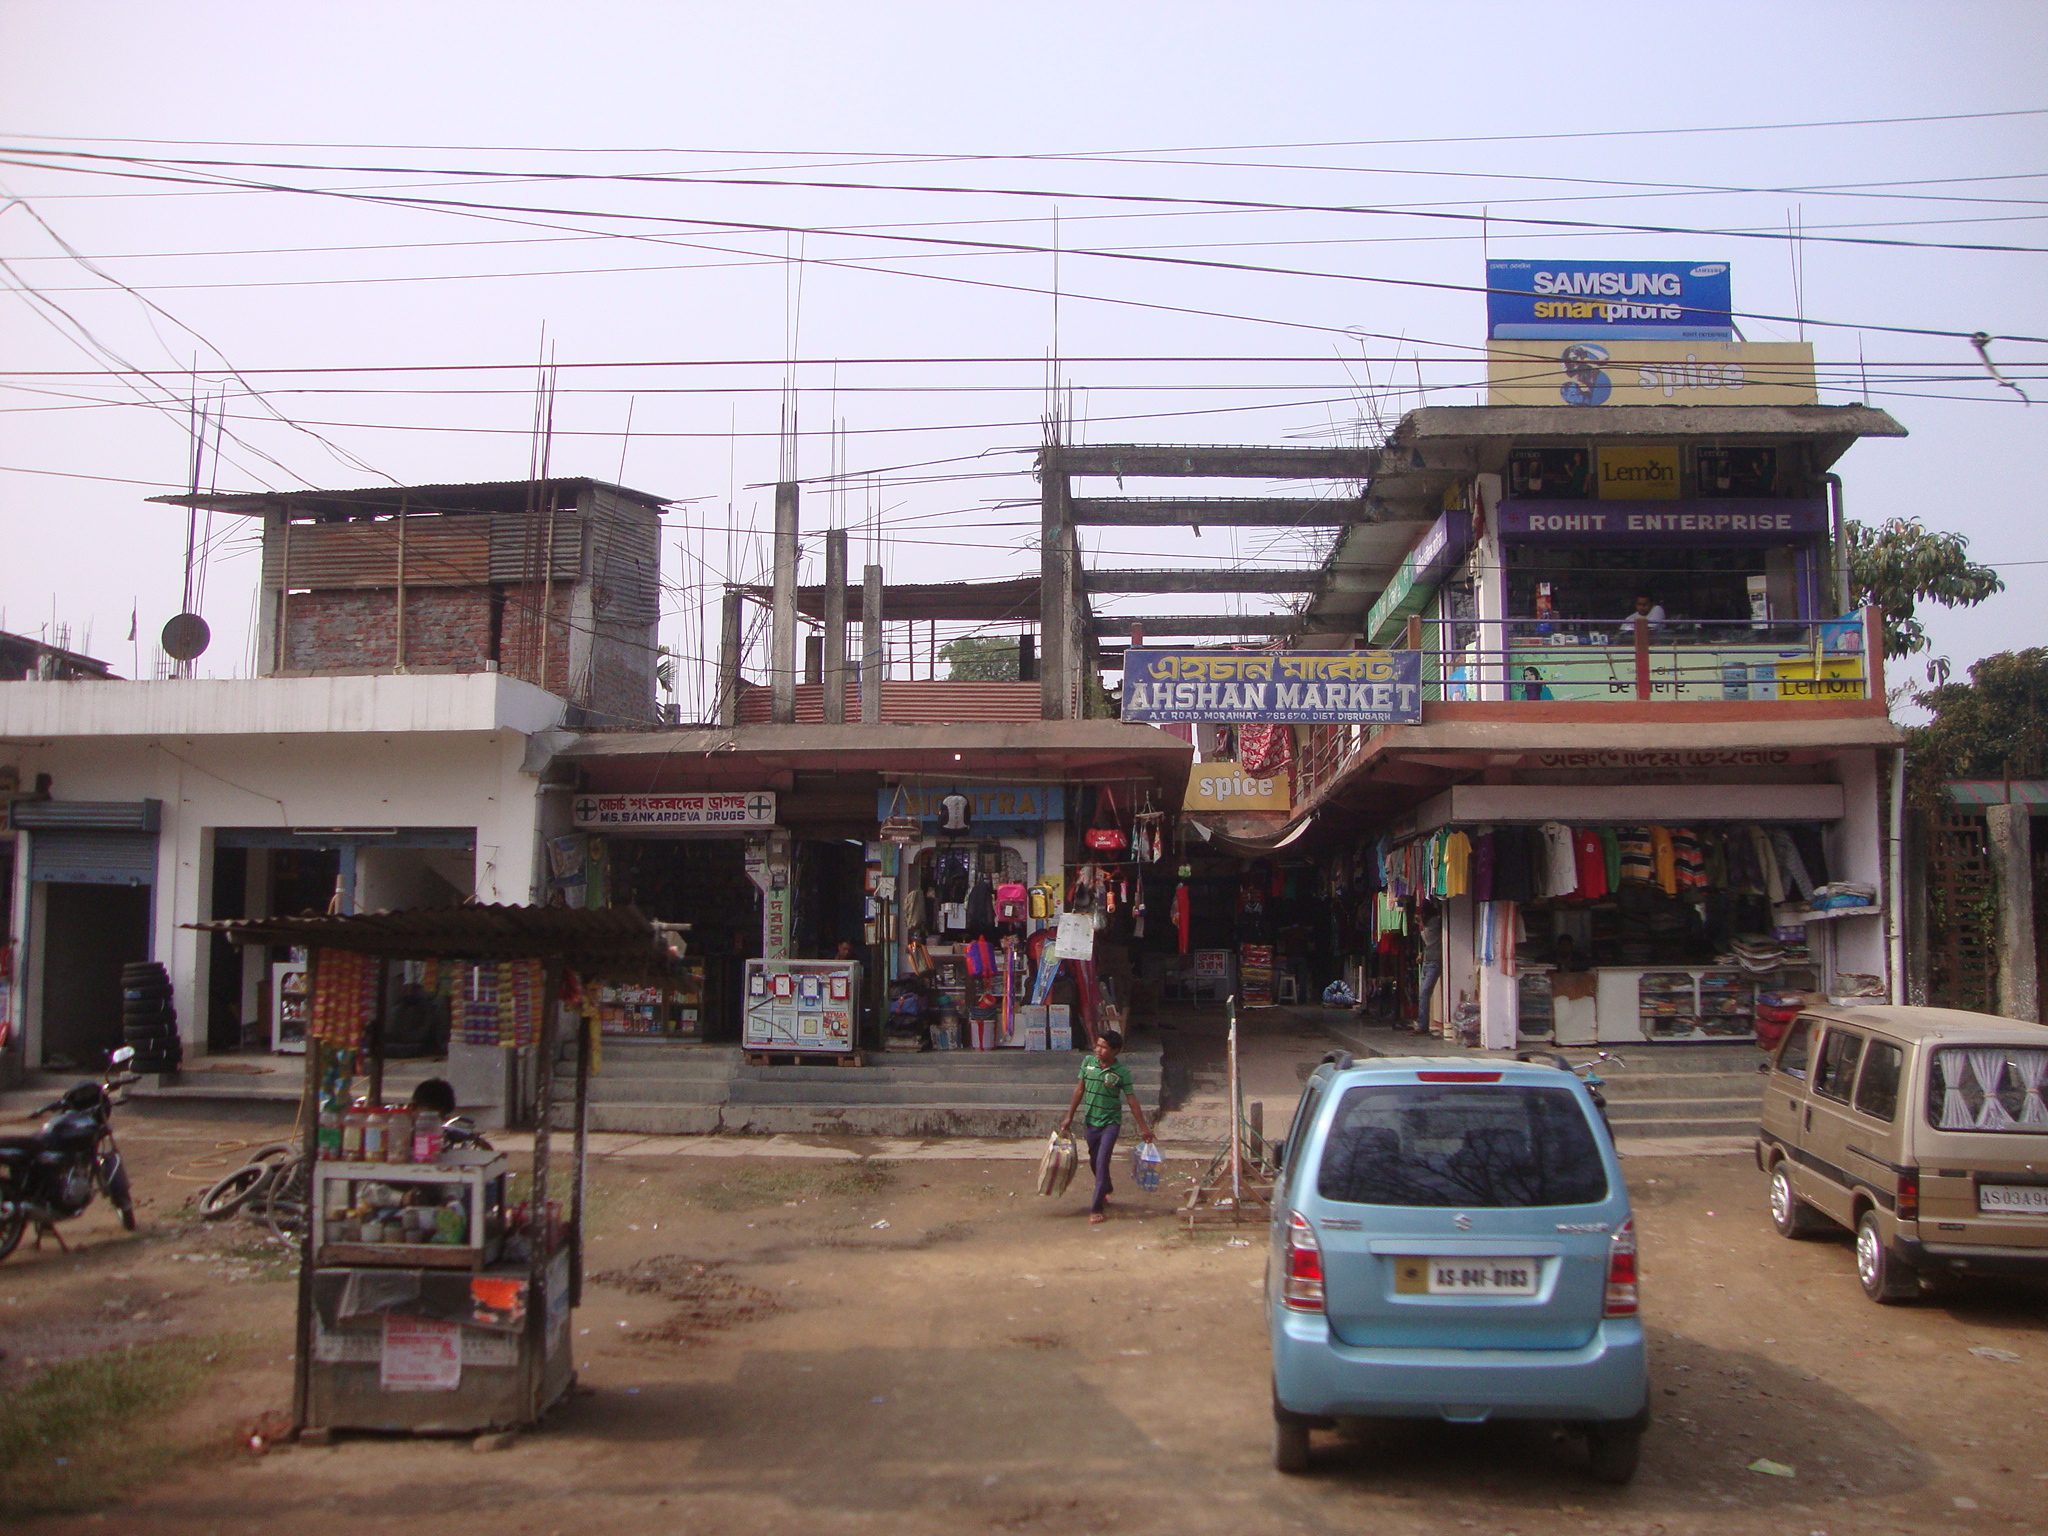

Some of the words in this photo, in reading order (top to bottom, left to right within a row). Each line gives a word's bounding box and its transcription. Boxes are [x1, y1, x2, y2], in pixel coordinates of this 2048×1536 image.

[1534, 271, 1681, 296] SAMSUNG
[1534, 298, 1682, 323] smartphone
[1638, 354, 1745, 398] spice
[1603, 461, 1674, 482] Lemon
[1529, 515, 1606, 531] ROHIT
[1628, 514, 1792, 530] ENTERPRISE
[1608, 676, 1630, 694] Be
[1781, 675, 1858, 696] Lemon
[1128, 682, 1268, 712] AHSHAN
[1275, 682, 1416, 712] MARKET
[1337, 711, 1391, 720] DIBRUGARH
[1199, 770, 1274, 802] spice
[622, 811, 701, 823] SANKARDEVA
[706, 811, 746, 822] DRUGS
